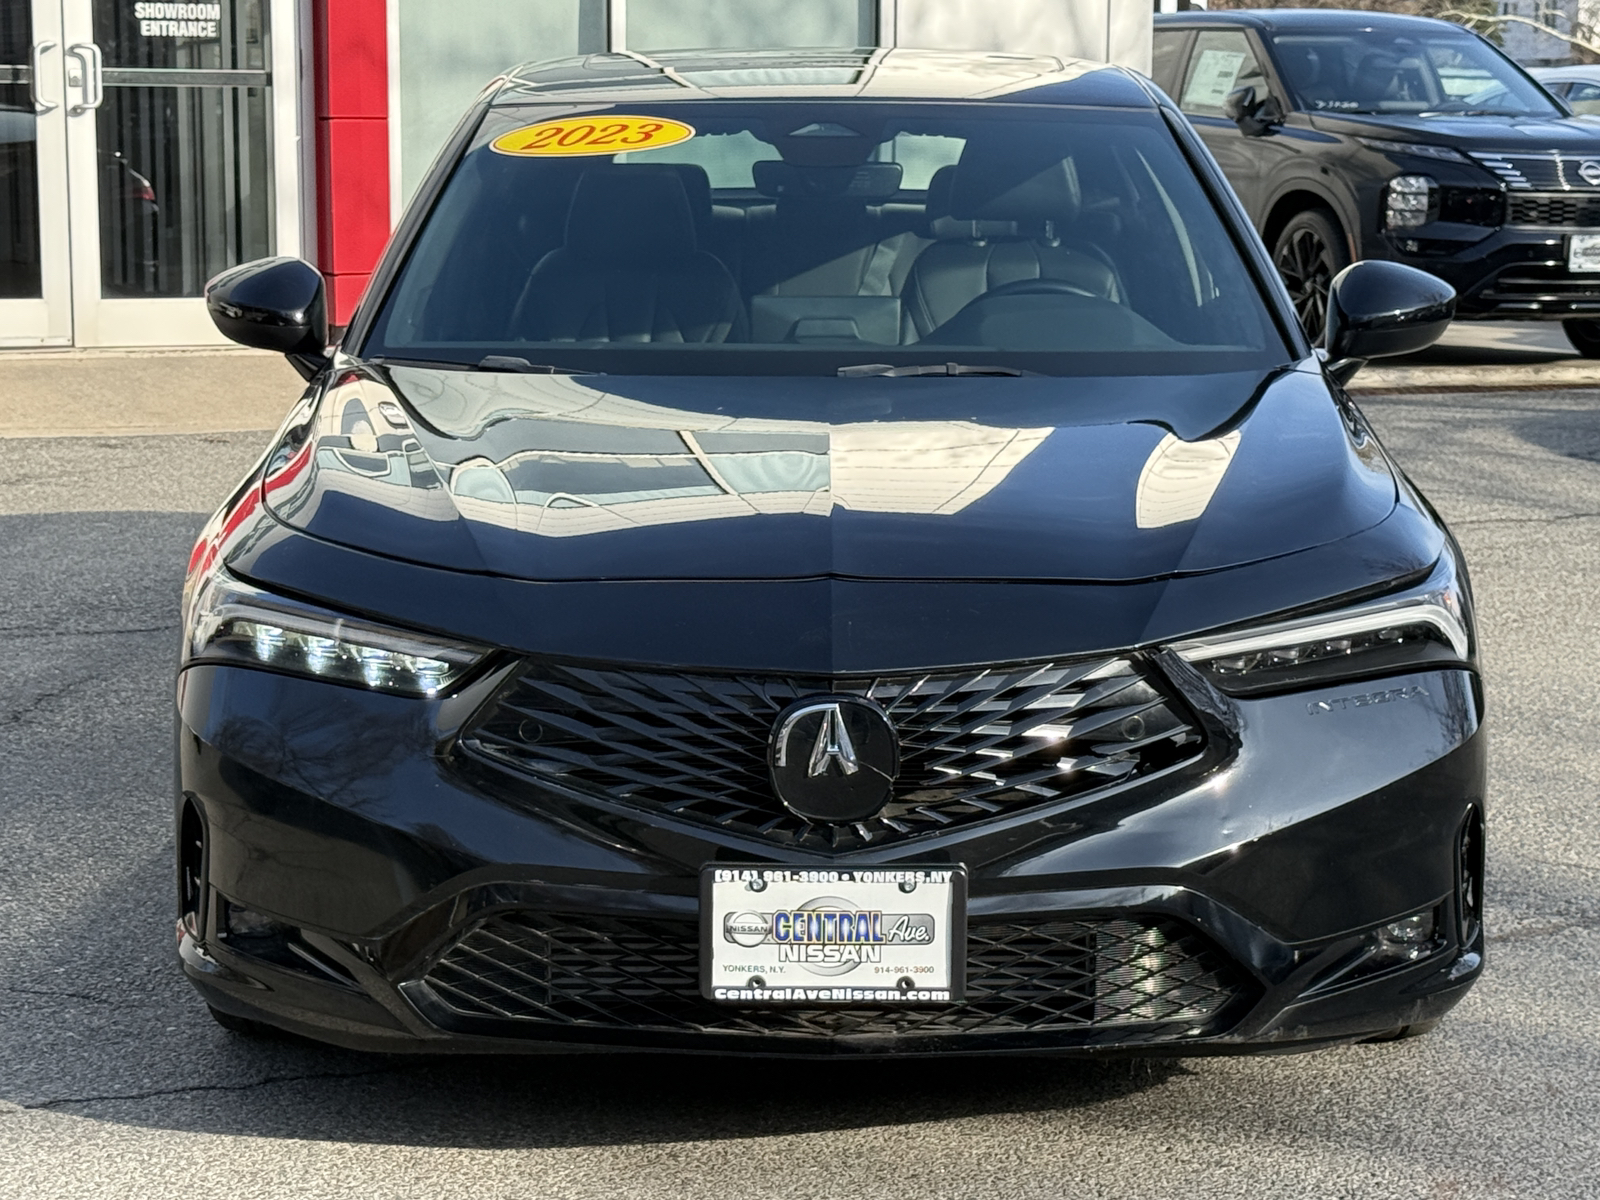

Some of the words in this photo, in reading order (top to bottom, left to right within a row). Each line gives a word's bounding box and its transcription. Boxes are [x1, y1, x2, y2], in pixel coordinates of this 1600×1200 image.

[134, 2, 220, 20] SHOWROOM
[140, 20, 217, 37] ENTRANCE
[520, 123, 664, 150] 2023
[1306, 686, 1429, 715] INTEGRA
[763, 871, 839, 883] 961-3900
[773, 911, 886, 943] CENTRAL
[888, 915, 930, 941] Ave.
[779, 944, 881, 963] NISSAN
[723, 965, 768, 974] YONKERS,
[874, 966, 935, 974] 914-961-3900
[714, 988, 950, 1000] CentralAveNissan.com
